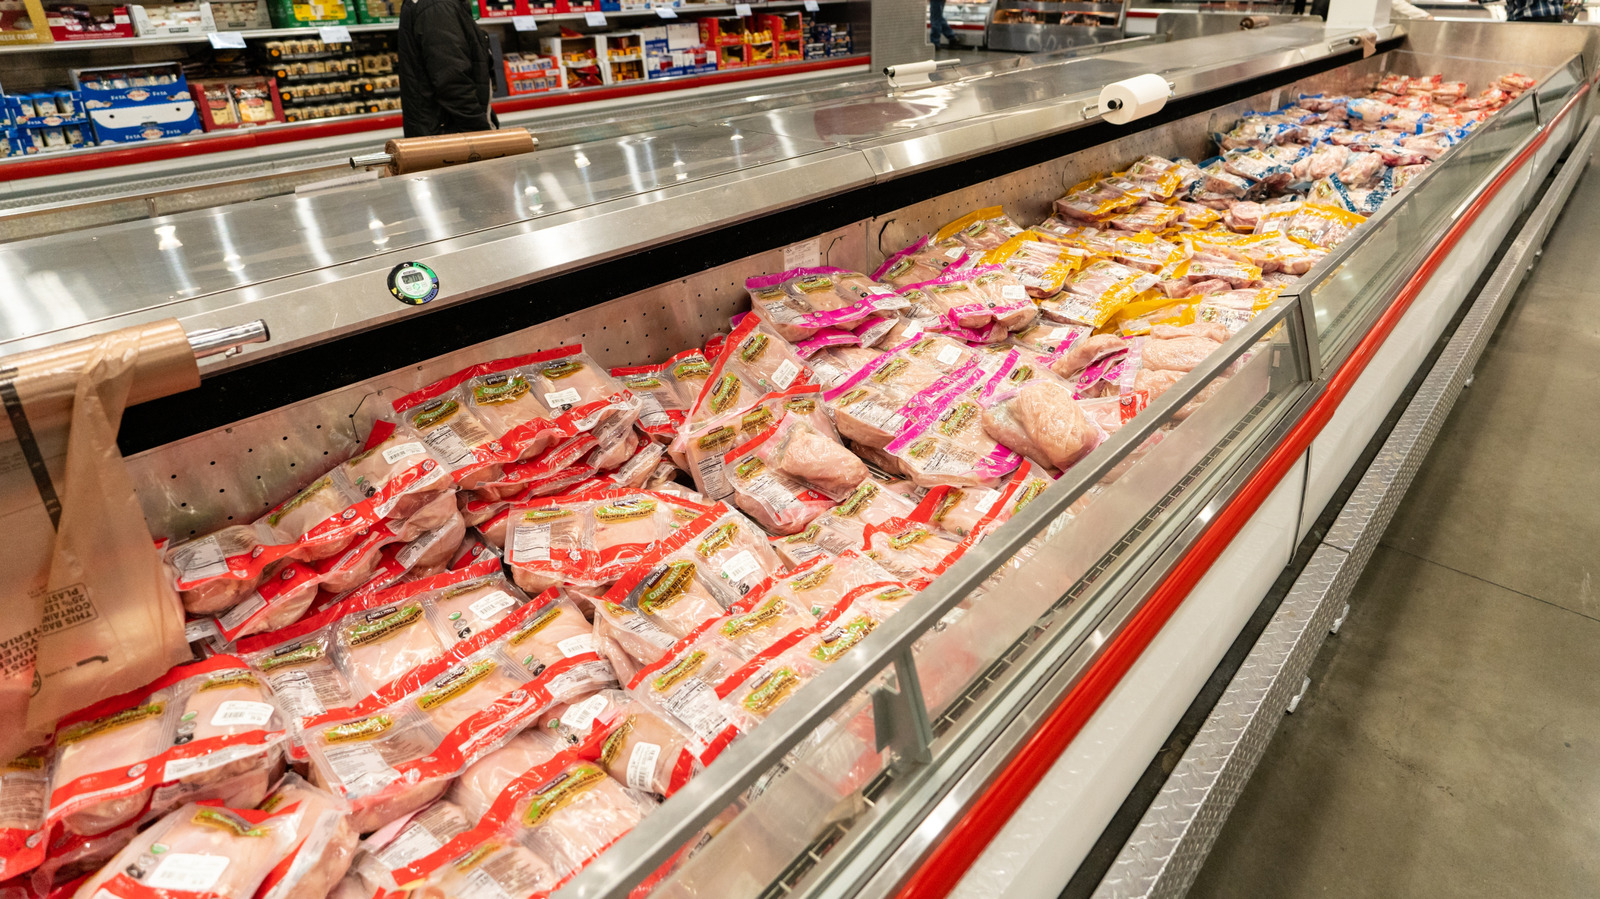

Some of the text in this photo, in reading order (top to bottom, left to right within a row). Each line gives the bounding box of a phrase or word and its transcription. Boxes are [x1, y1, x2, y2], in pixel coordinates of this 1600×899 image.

[649, 566, 681, 599] ORGANIC
[45, 588, 79, 604] PLAST
[62, 594, 85, 607] 25%
[42, 602, 91, 623] CONTAIN
[65, 610, 93, 625] THIS
[361, 609, 409, 632] ORGANIC
[351, 627, 388, 646] CHICKEN
